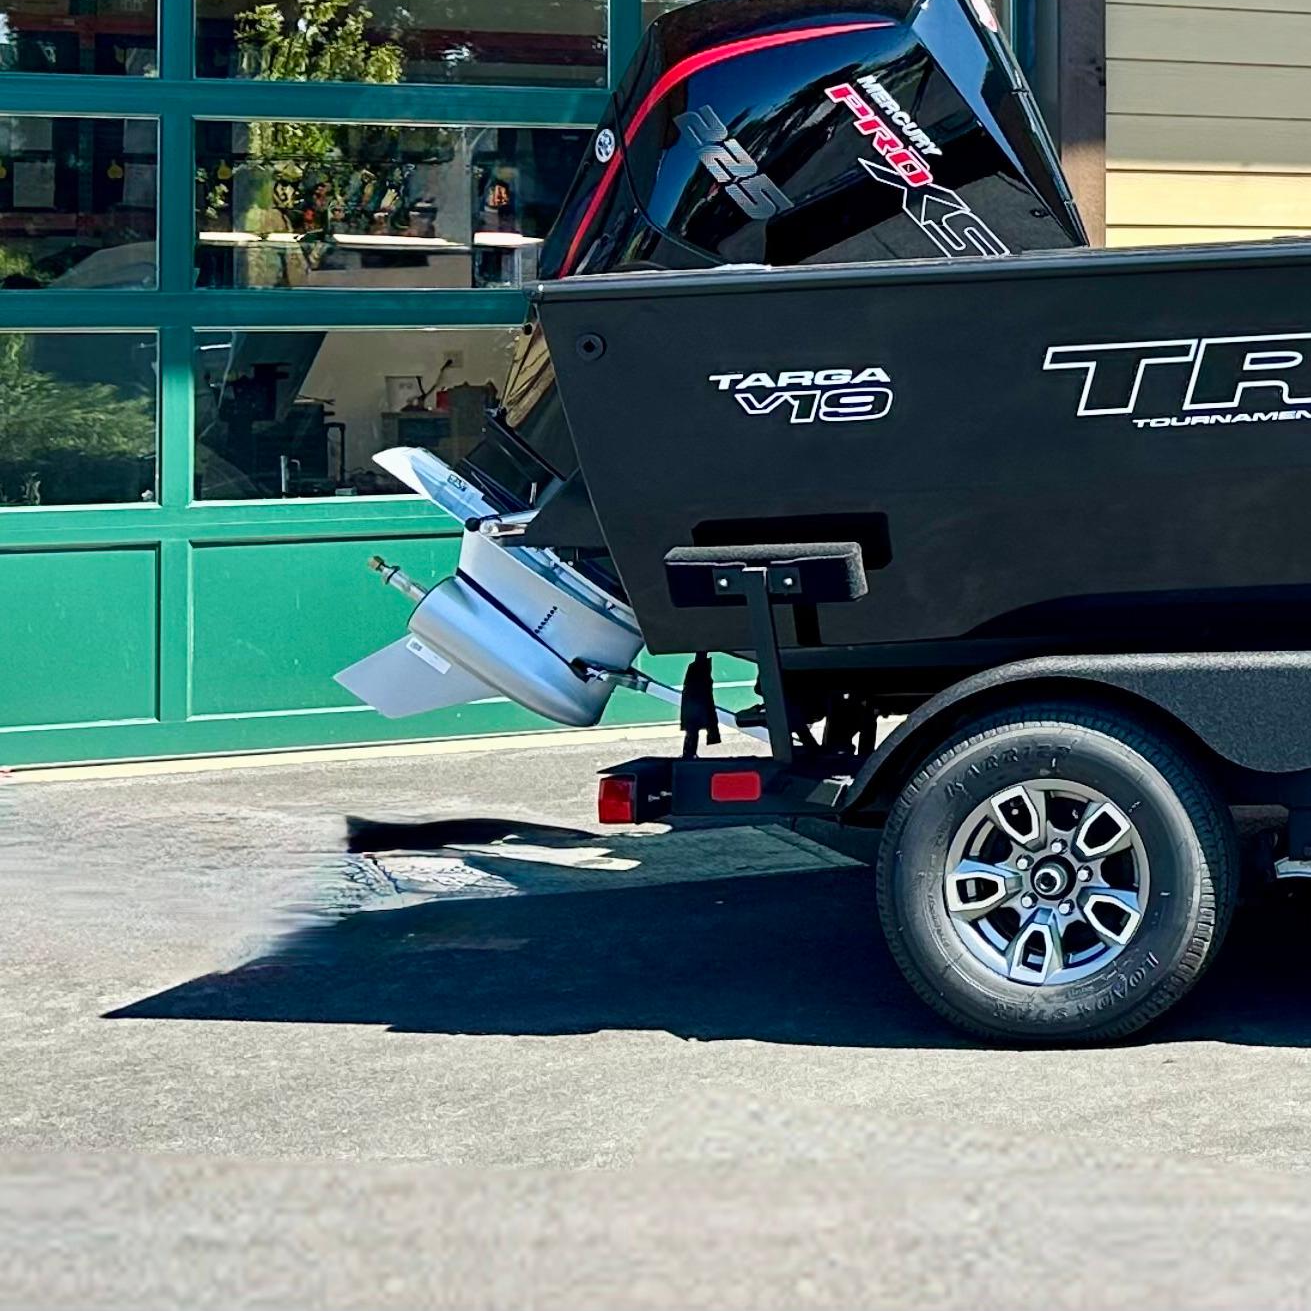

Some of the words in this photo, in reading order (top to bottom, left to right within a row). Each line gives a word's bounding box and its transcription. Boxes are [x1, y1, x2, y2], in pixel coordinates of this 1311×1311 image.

[825, 83, 934, 187] PRO
[856, 74, 943, 157] MERCURY
[675, 105, 795, 220] 225
[709, 367, 891, 390] TARGA
[734, 387, 893, 424] V19
